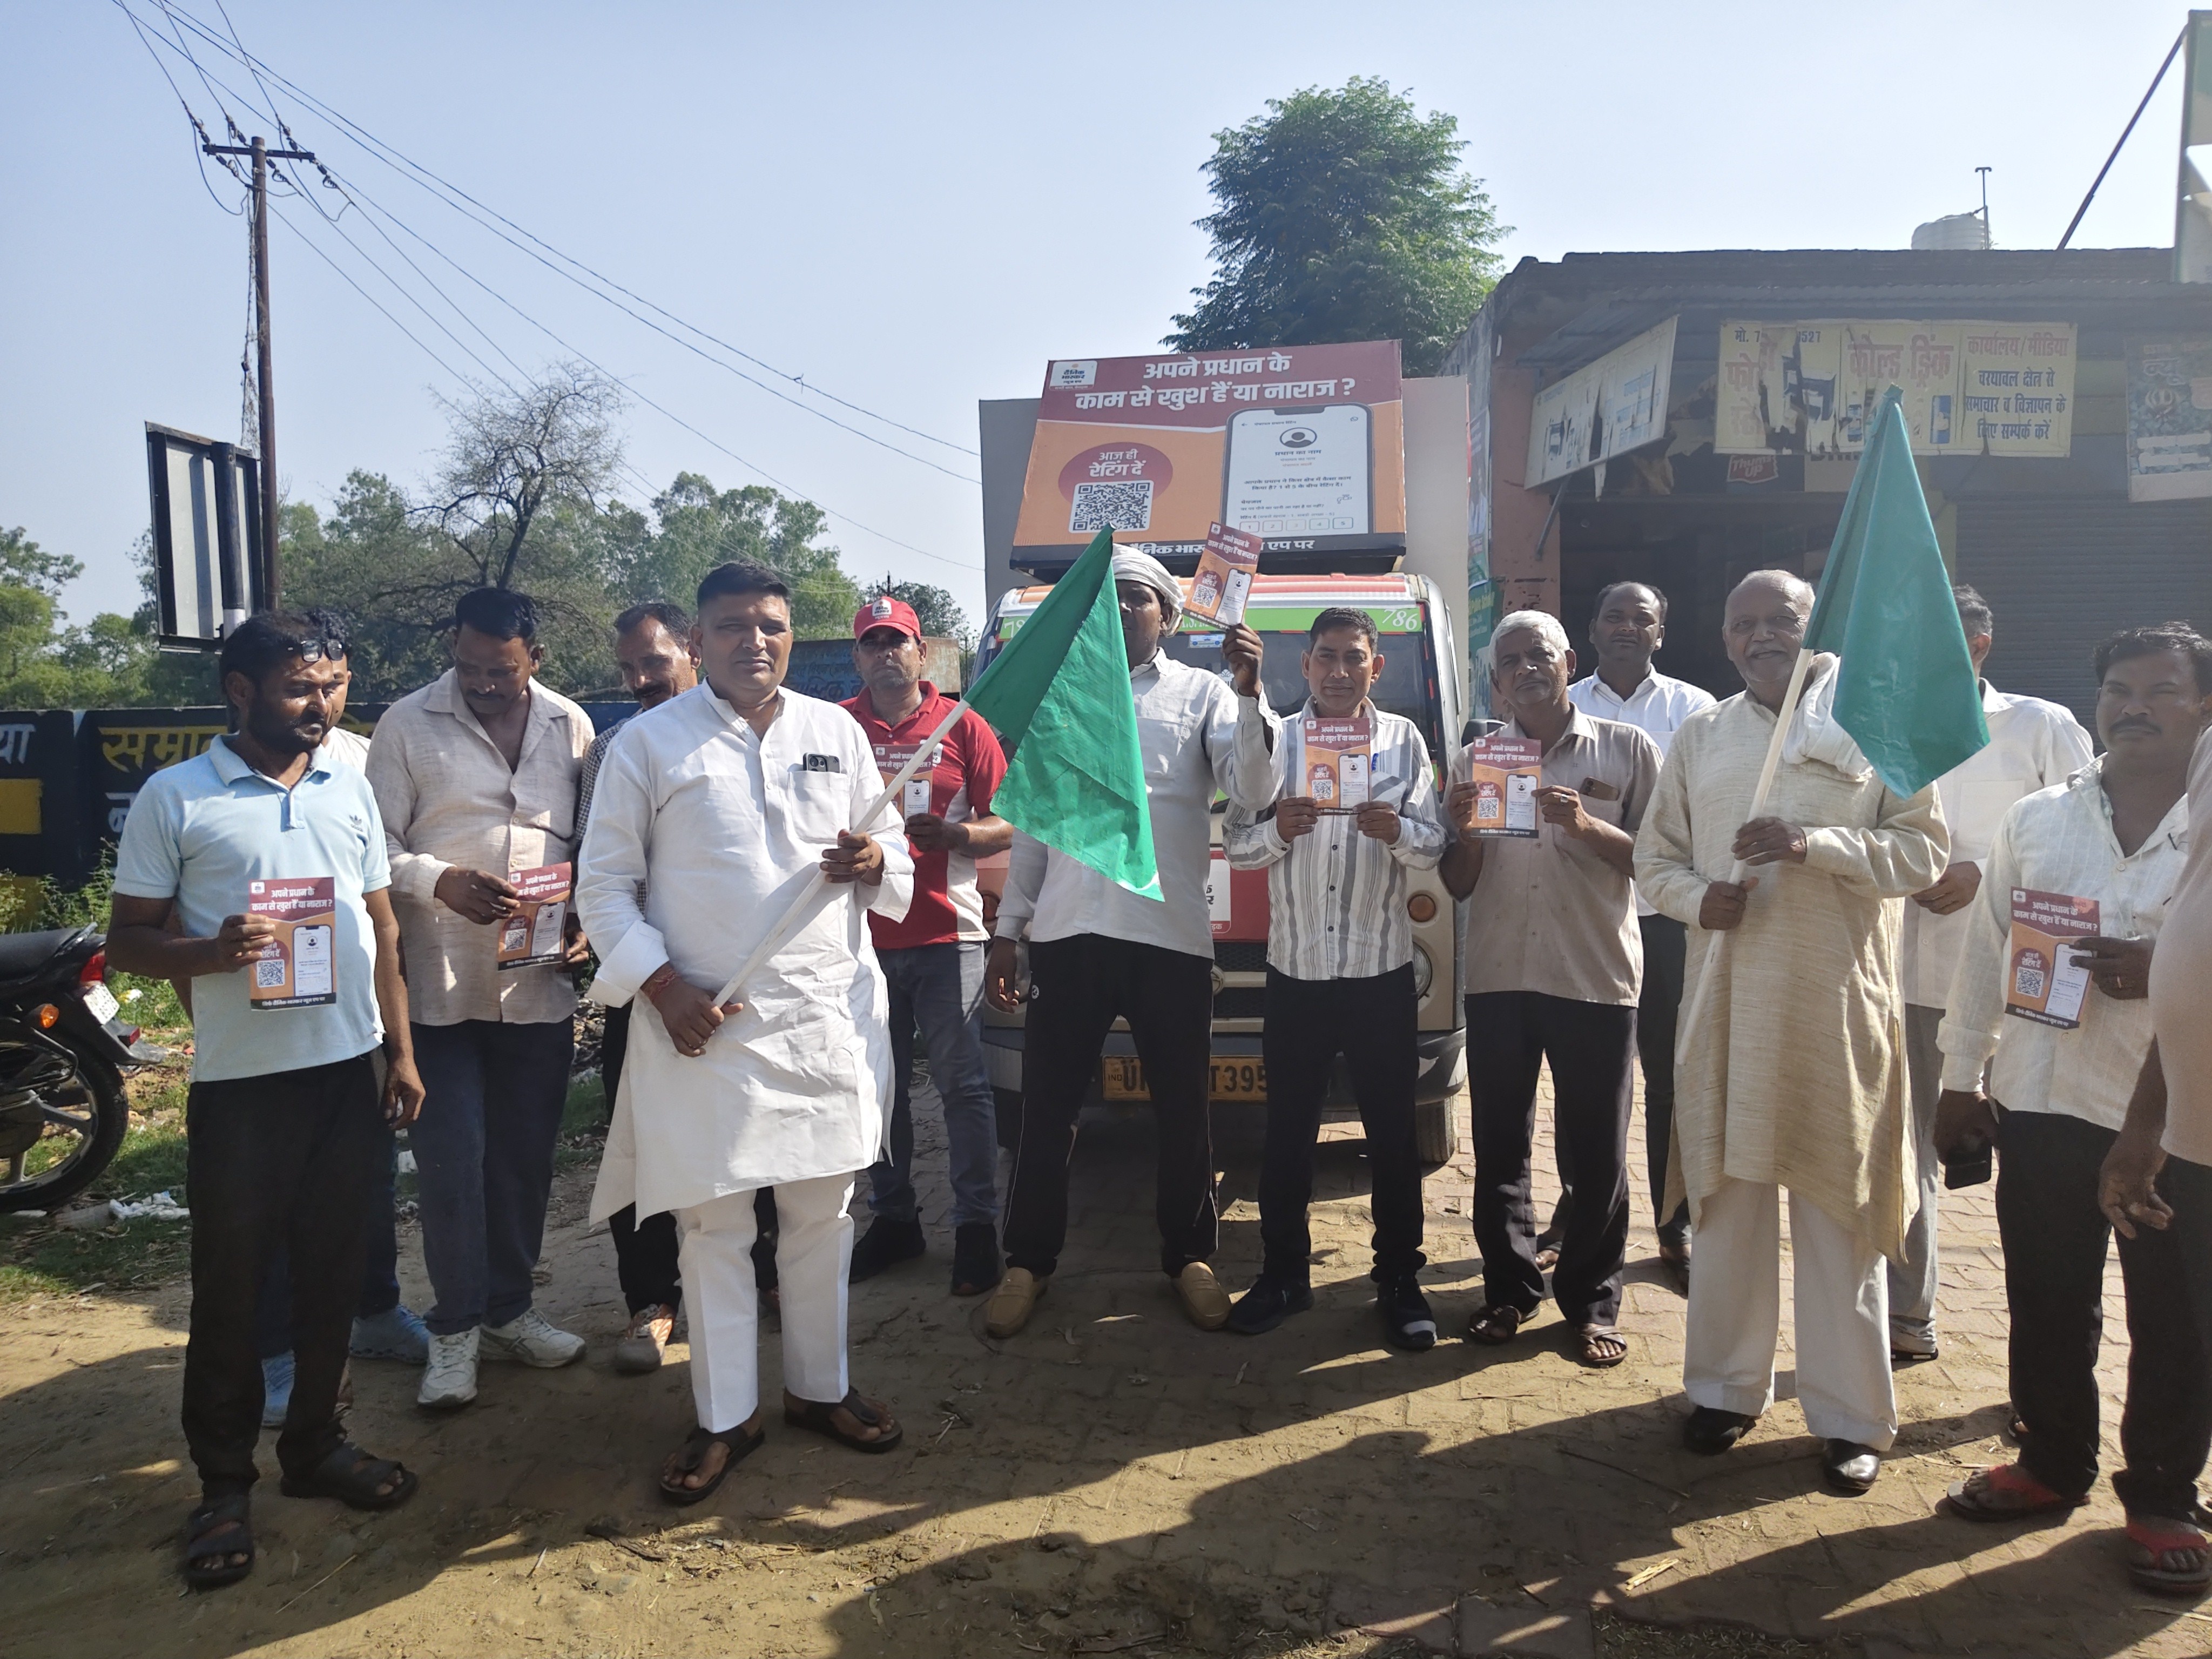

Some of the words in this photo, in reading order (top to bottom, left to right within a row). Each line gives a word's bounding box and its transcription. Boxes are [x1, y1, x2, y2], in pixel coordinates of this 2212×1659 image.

[1143, 356, 1201, 379] अपने
[1202, 357, 1265, 376] प्रधान
[1267, 351, 1292, 372] के
[1075, 391, 1128, 409] काम
[1129, 385, 1155, 407] से
[1156, 387, 1209, 410] खुश
[1211, 381, 1232, 402] हैं
[1232, 384, 1261, 401] या
[1262, 380, 1338, 399] नाराज
[1341, 378, 1355, 395] ?
[1966, 395, 2000, 413] समाचार
[2003, 397, 2011, 413] व
[2015, 393, 2052, 413] विज्ञापन
[2055, 394, 2066, 413] के
[1098, 451, 1124, 461] आज
[1125, 448, 1138, 459] ही
[1089, 460, 1130, 477] रेटिंग
[1130, 460, 1147, 475] दें
[1267, 542, 1292, 550] एप
[1294, 540, 1316, 550] पर
[1382, 609, 1418, 630] 786
[271, 887, 288, 898] अपने
[289, 888, 307, 897] प्रधान
[307, 886, 315, 895] के
[252, 903, 267, 911] काम
[269, 900, 276, 910] से
[276, 902, 291, 912] खुश
[307, 900, 327, 908] नाराज
[2033, 901, 2049, 911] अपने
[2051, 905, 2069, 914] प्रधान
[2070, 906, 2078, 915] के
[2013, 910, 2029, 919] काम
[2030, 912, 2038, 921] से
[2038, 914, 2053, 925] खुश
[2060, 918, 2069, 926] या
[2070, 920, 2092, 930] नाराज
